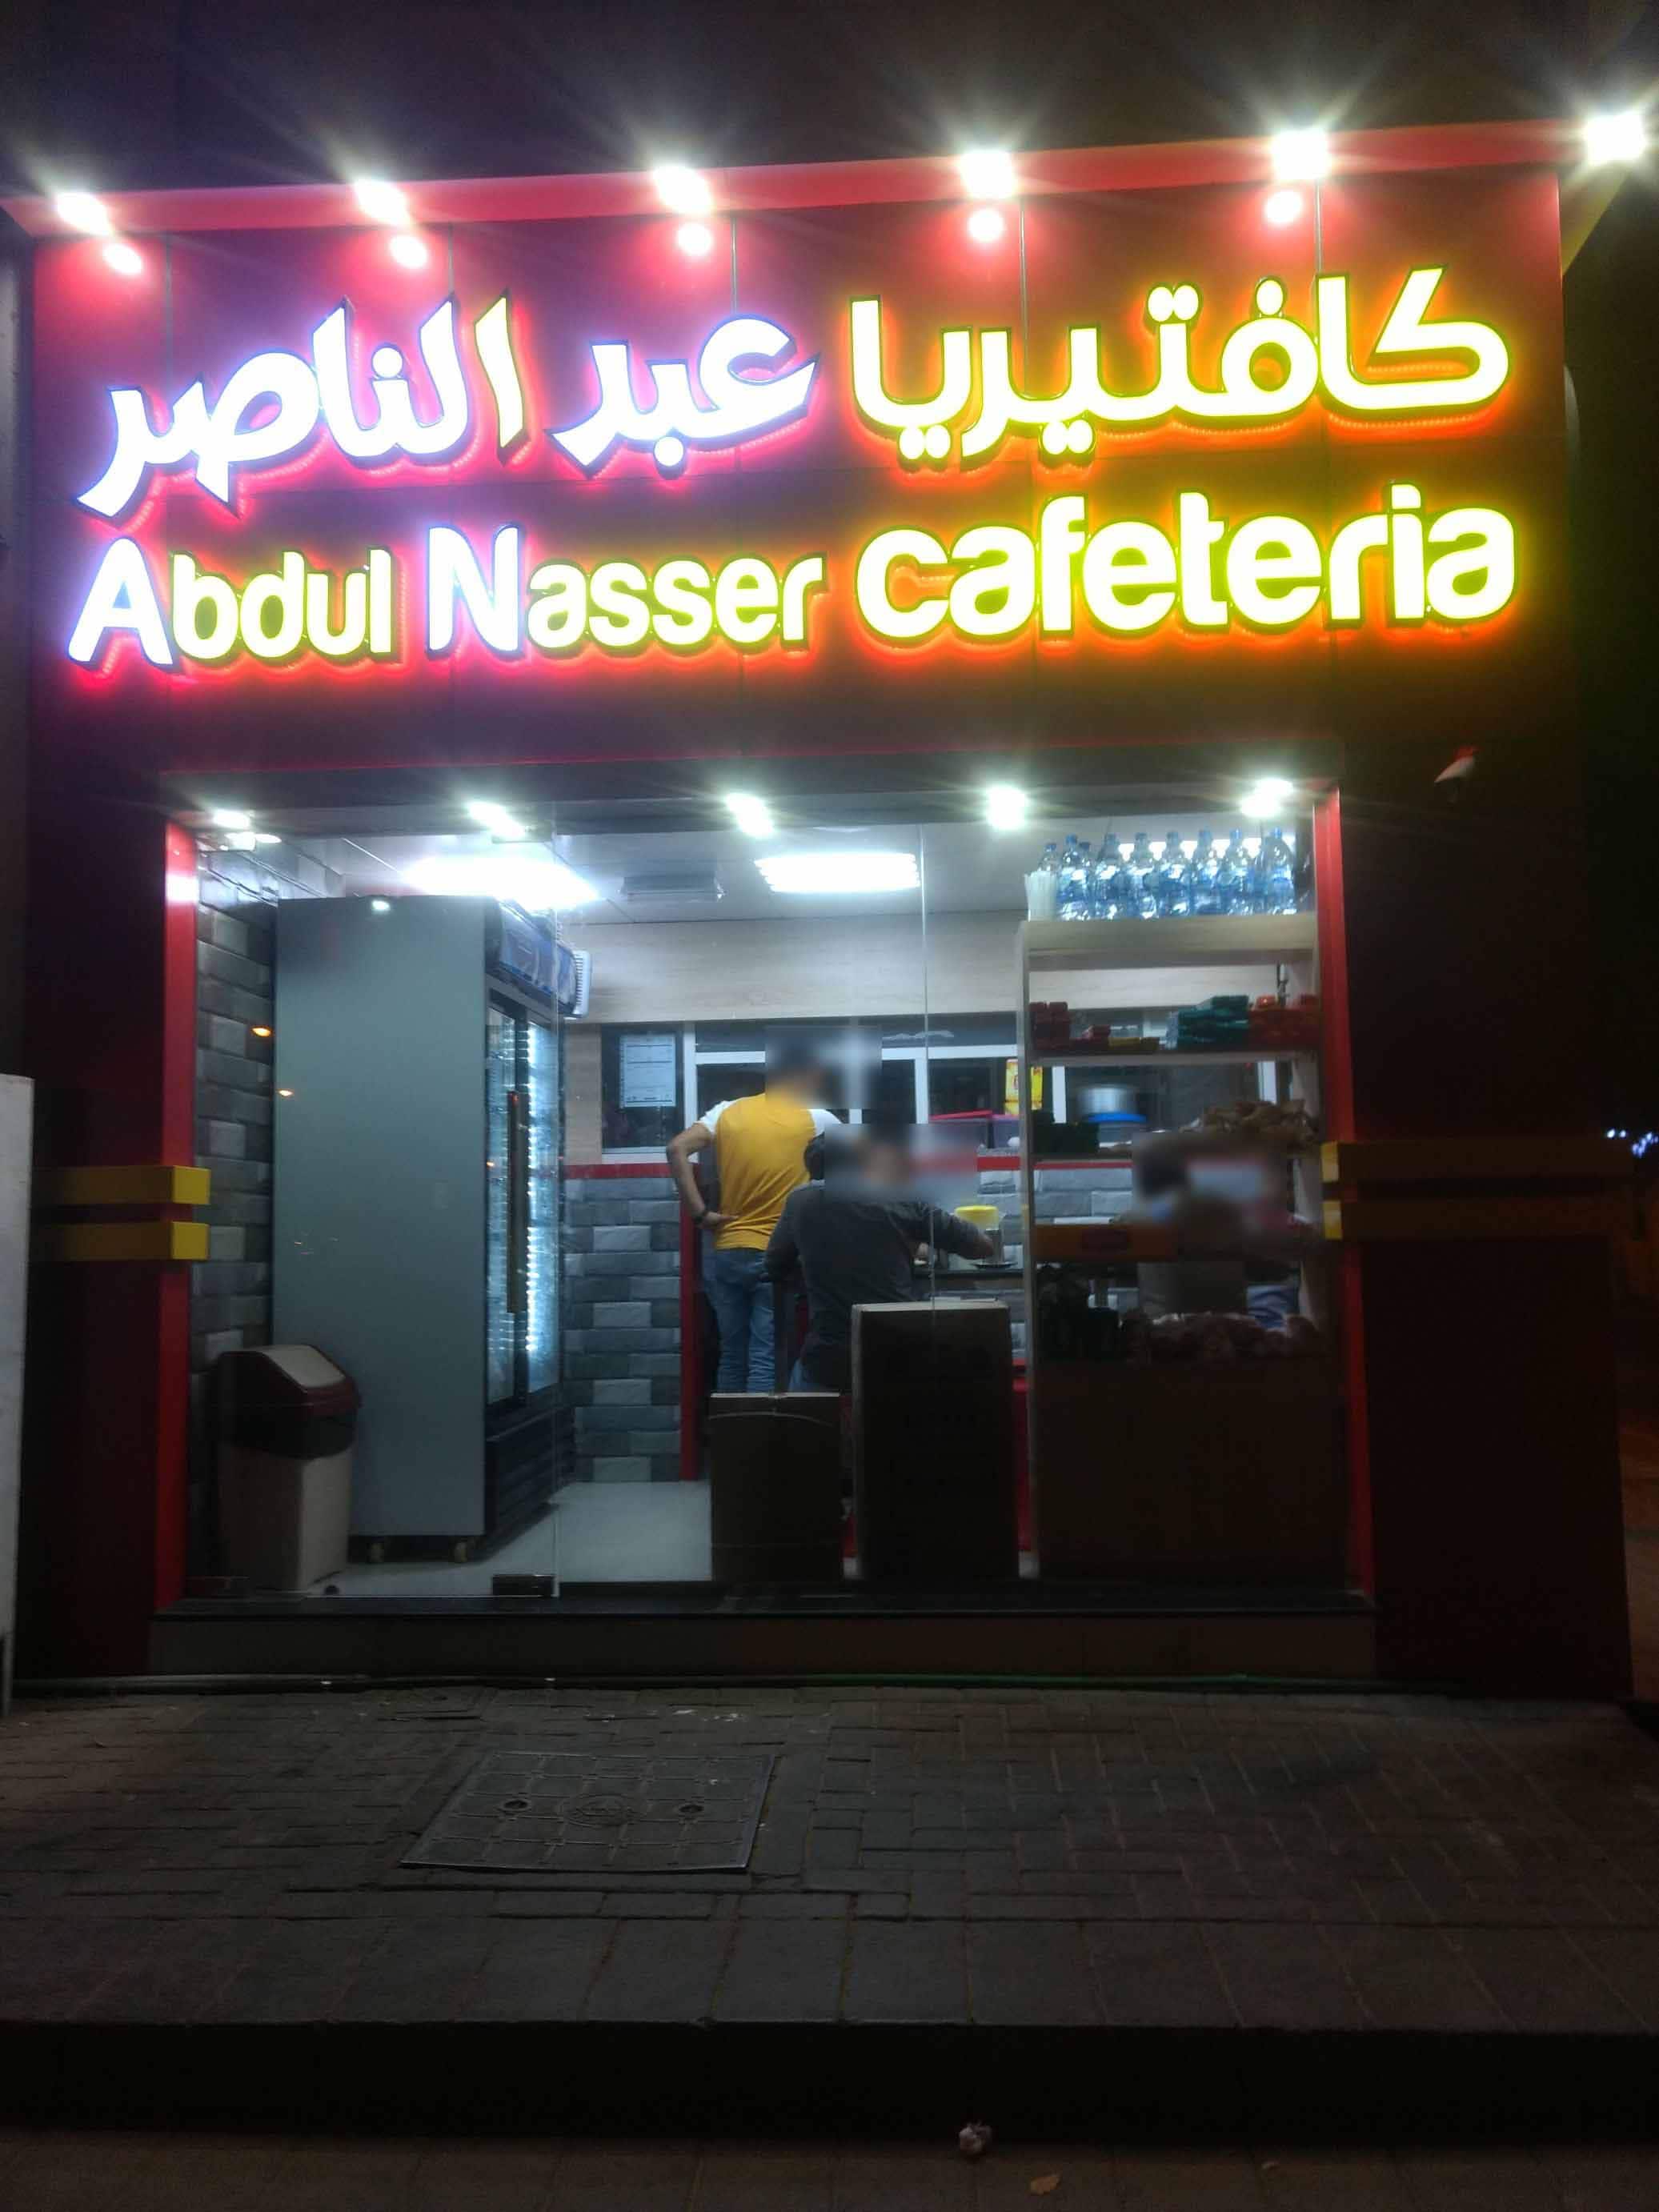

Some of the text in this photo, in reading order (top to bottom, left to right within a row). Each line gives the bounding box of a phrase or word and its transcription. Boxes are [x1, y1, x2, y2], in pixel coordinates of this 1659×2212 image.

[76, 266, 1511, 526] كافتيريا عبد الناصر
[67, 482, 1517, 670] Abdul Nasser cafeteria
